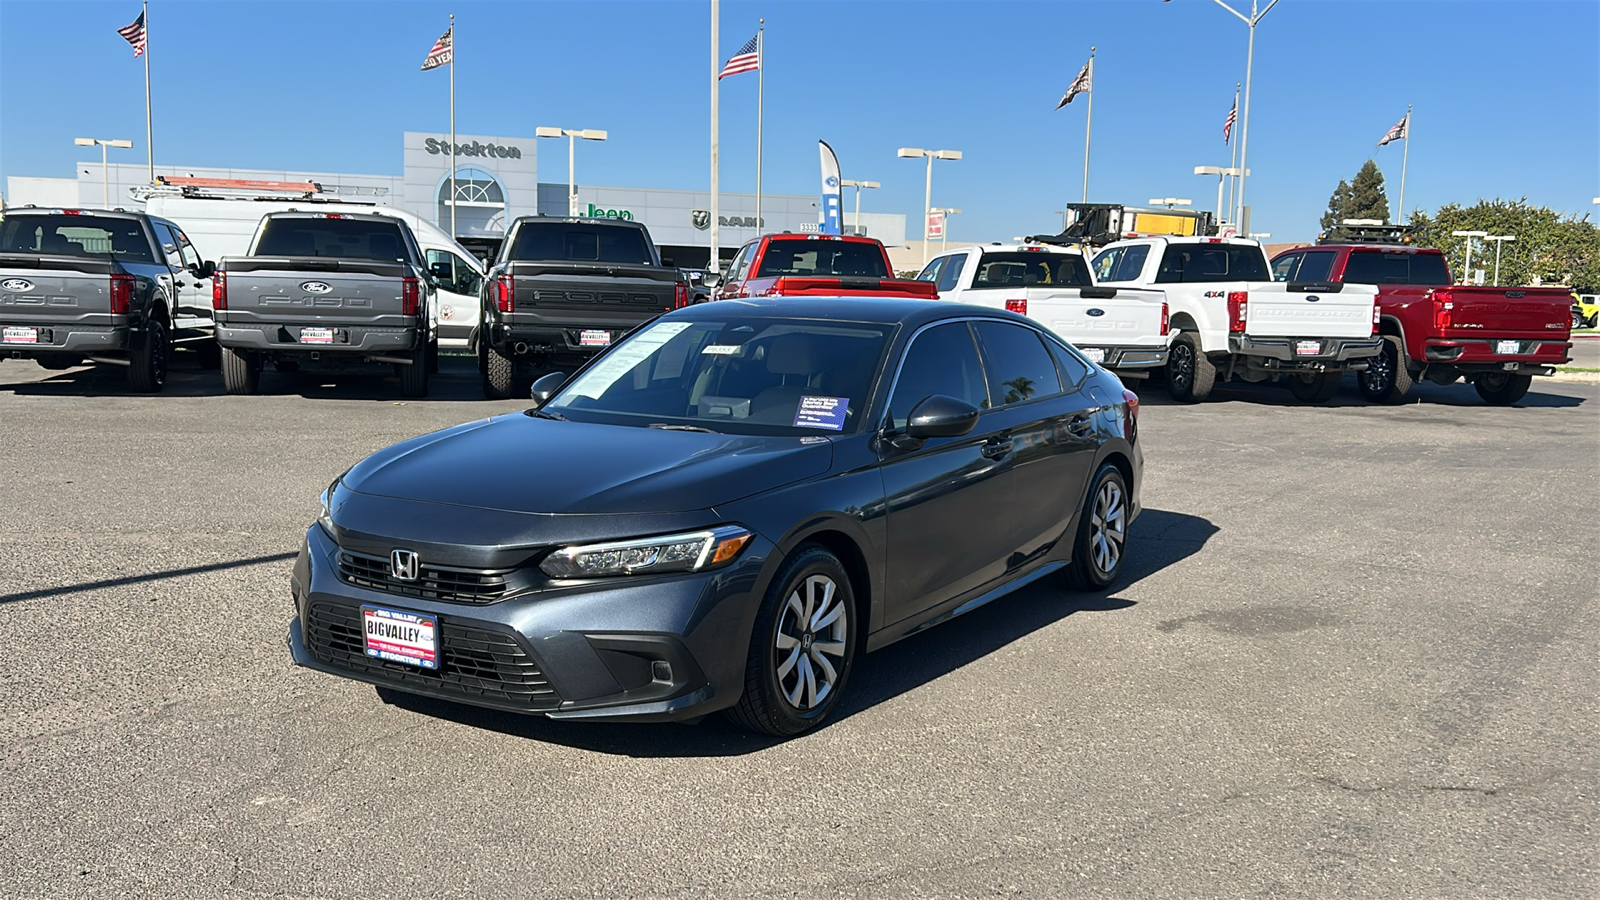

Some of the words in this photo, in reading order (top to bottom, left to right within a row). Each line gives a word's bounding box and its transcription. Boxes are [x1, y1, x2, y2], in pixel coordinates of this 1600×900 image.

[425, 138, 521, 159] Stockton
[579, 204, 634, 220] Jeep
[718, 216, 764, 227] RAM
[259, 295, 373, 308] F-150
[533, 290, 658, 304] FORD
[1051, 319, 1138, 330] F-150
[367, 620, 420, 643] BIGVALLEY
[380, 651, 421, 666] STOCKTON
